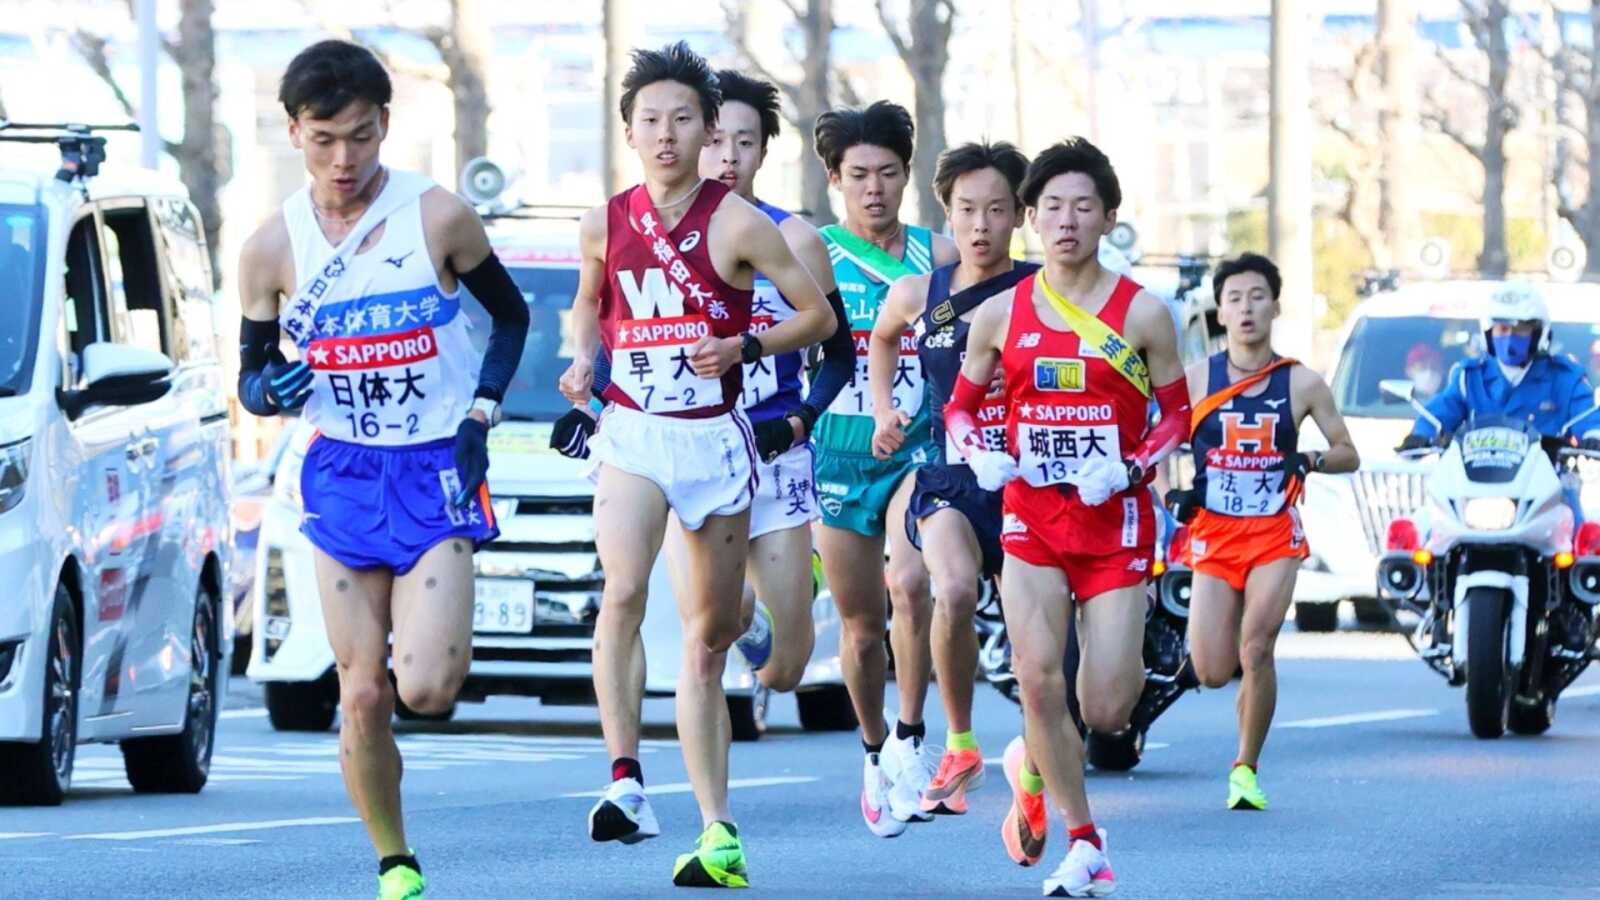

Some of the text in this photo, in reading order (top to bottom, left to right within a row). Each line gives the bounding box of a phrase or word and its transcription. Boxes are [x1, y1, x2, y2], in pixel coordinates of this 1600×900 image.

[616, 268, 685, 320] W
[632, 321, 709, 342] SAPPORO
[334, 335, 432, 366] SAPPORO
[629, 348, 698, 383] 早大
[329, 367, 426, 409] 日体大
[641, 386, 697, 409] 7-2
[347, 412, 420, 439] 16-2
[1036, 404, 1113, 421] SAPPORO
[1029, 429, 1108, 460] 城西大
[1219, 413, 1280, 452] H
[1220, 472, 1273, 495] 法大
[1224, 495, 1269, 513] 18-2
